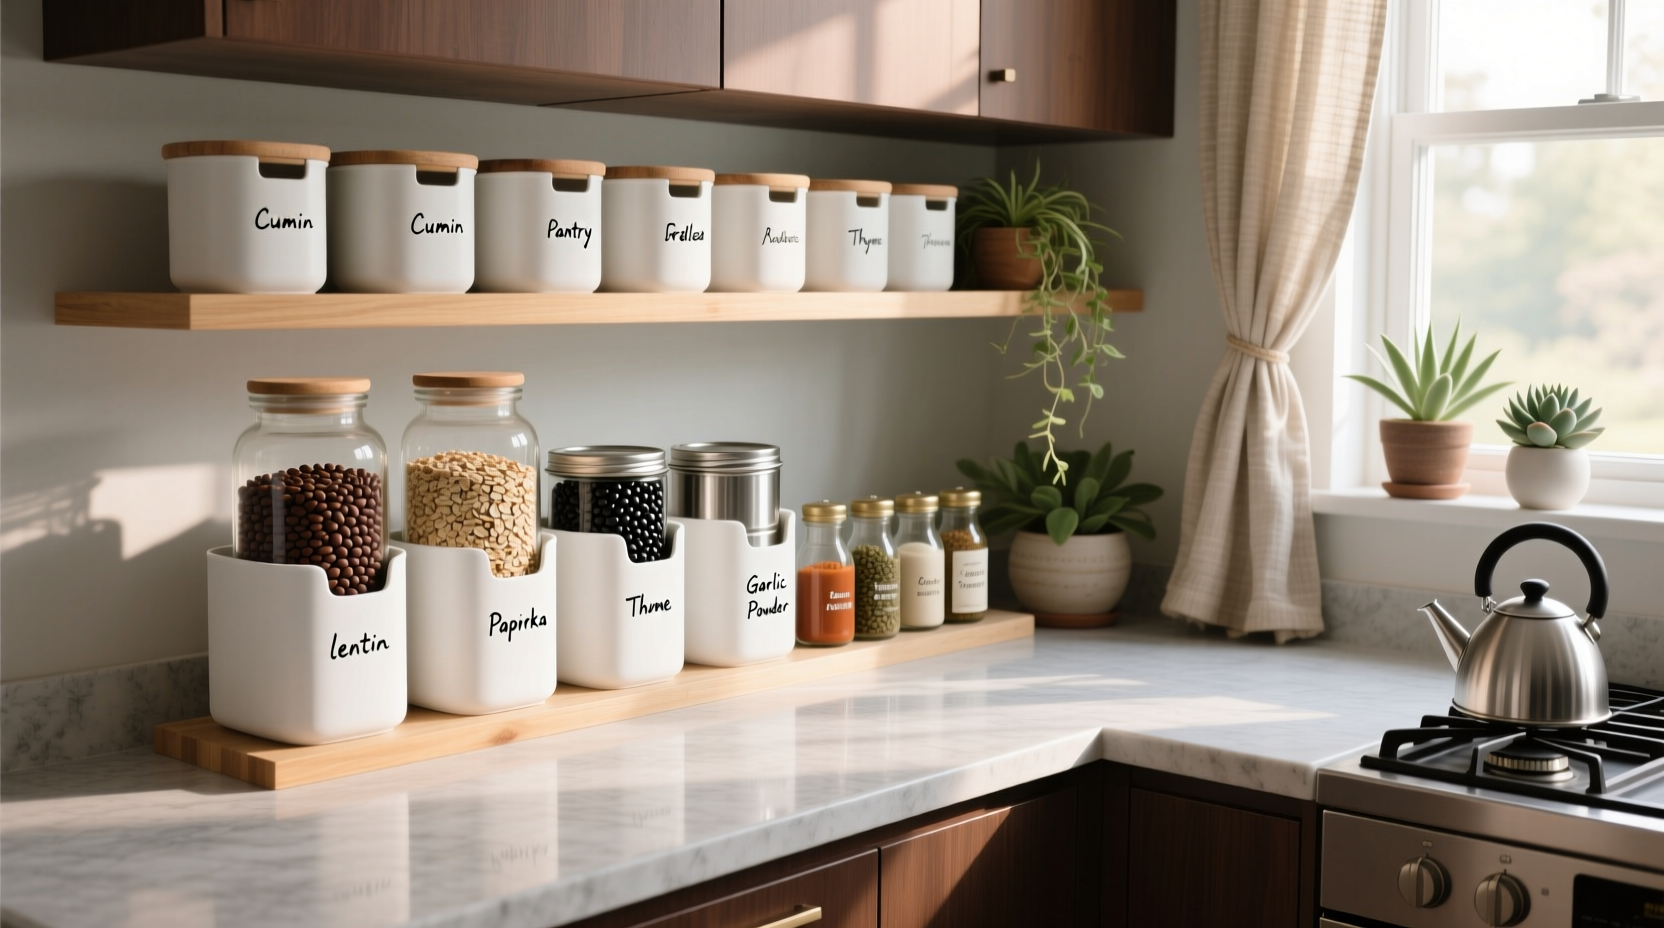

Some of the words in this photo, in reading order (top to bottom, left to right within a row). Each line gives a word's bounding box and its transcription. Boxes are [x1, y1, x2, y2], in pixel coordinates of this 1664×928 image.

[254, 207, 314, 230] Cumin
[410, 212, 464, 235] Cumin
[547, 218, 593, 249] Pantry
[746, 572, 787, 594] Garlic
[488, 607, 548, 642] Papirka
